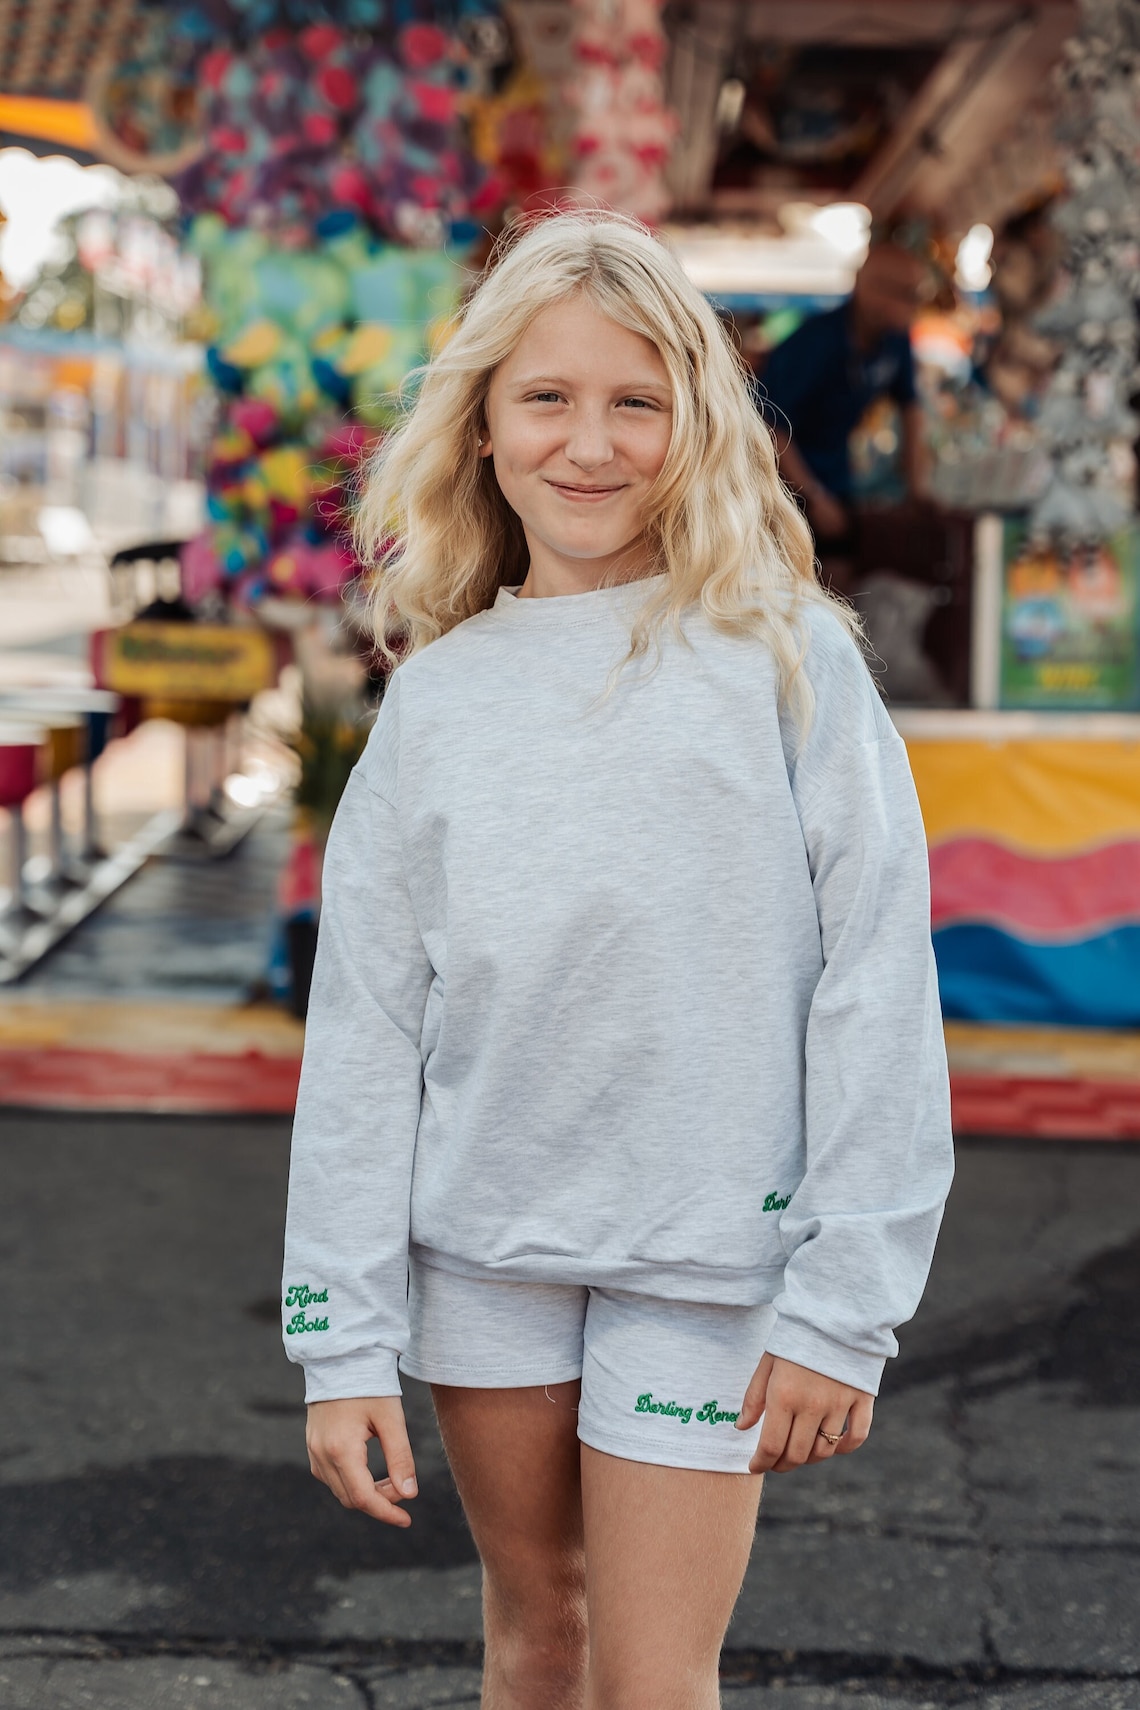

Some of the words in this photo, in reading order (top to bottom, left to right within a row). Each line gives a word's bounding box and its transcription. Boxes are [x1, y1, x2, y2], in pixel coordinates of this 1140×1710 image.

[285, 1284, 329, 1308] Kind
[286, 1311, 330, 1335] Bold
[634, 1392, 693, 1424] Darling
[695, 1400, 740, 1428] Rene
